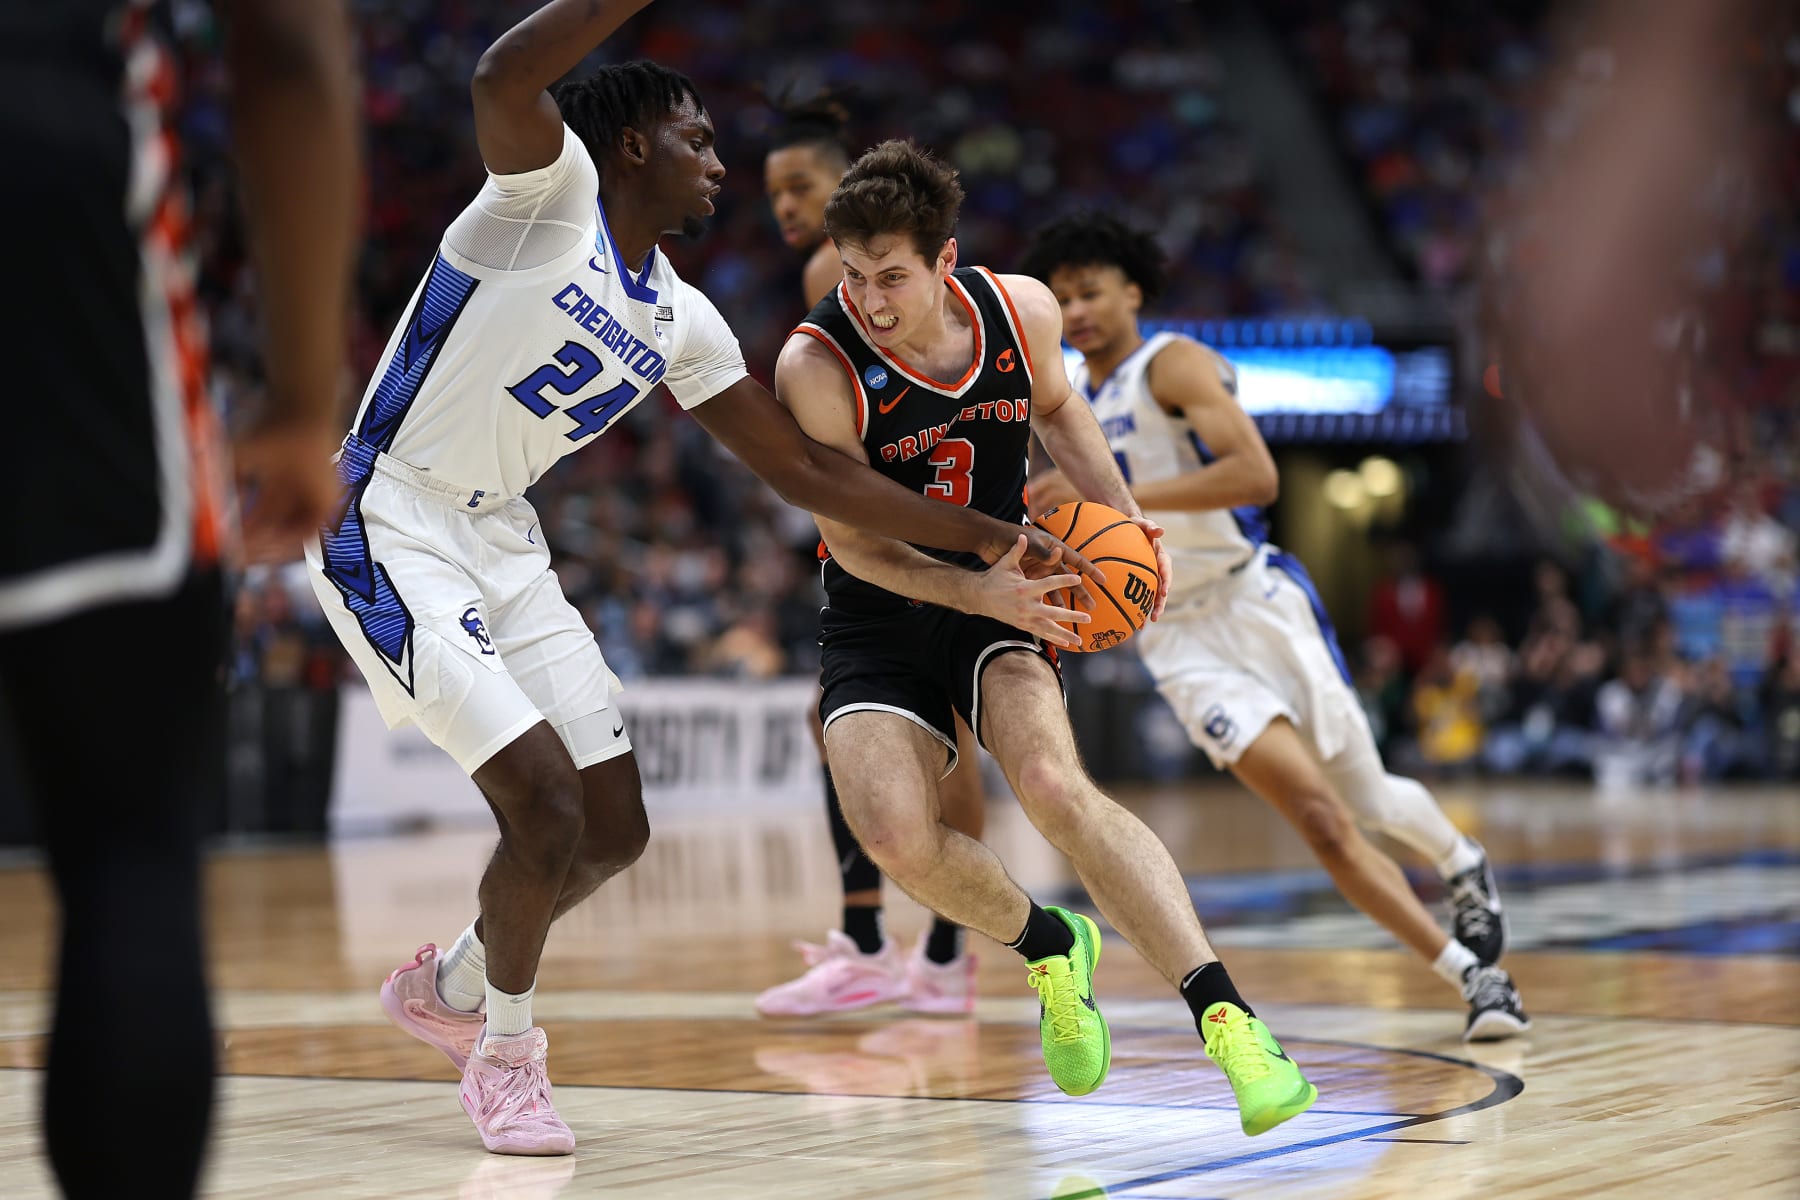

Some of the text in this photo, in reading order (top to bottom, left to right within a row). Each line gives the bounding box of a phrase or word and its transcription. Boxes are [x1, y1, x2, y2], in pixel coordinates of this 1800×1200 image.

[552, 282, 667, 385] CREIGHTON
[504, 340, 640, 442] 24
[869, 372, 888, 386] NCAA
[880, 398, 1028, 462] PRINETON
[924, 437, 975, 507] 3
